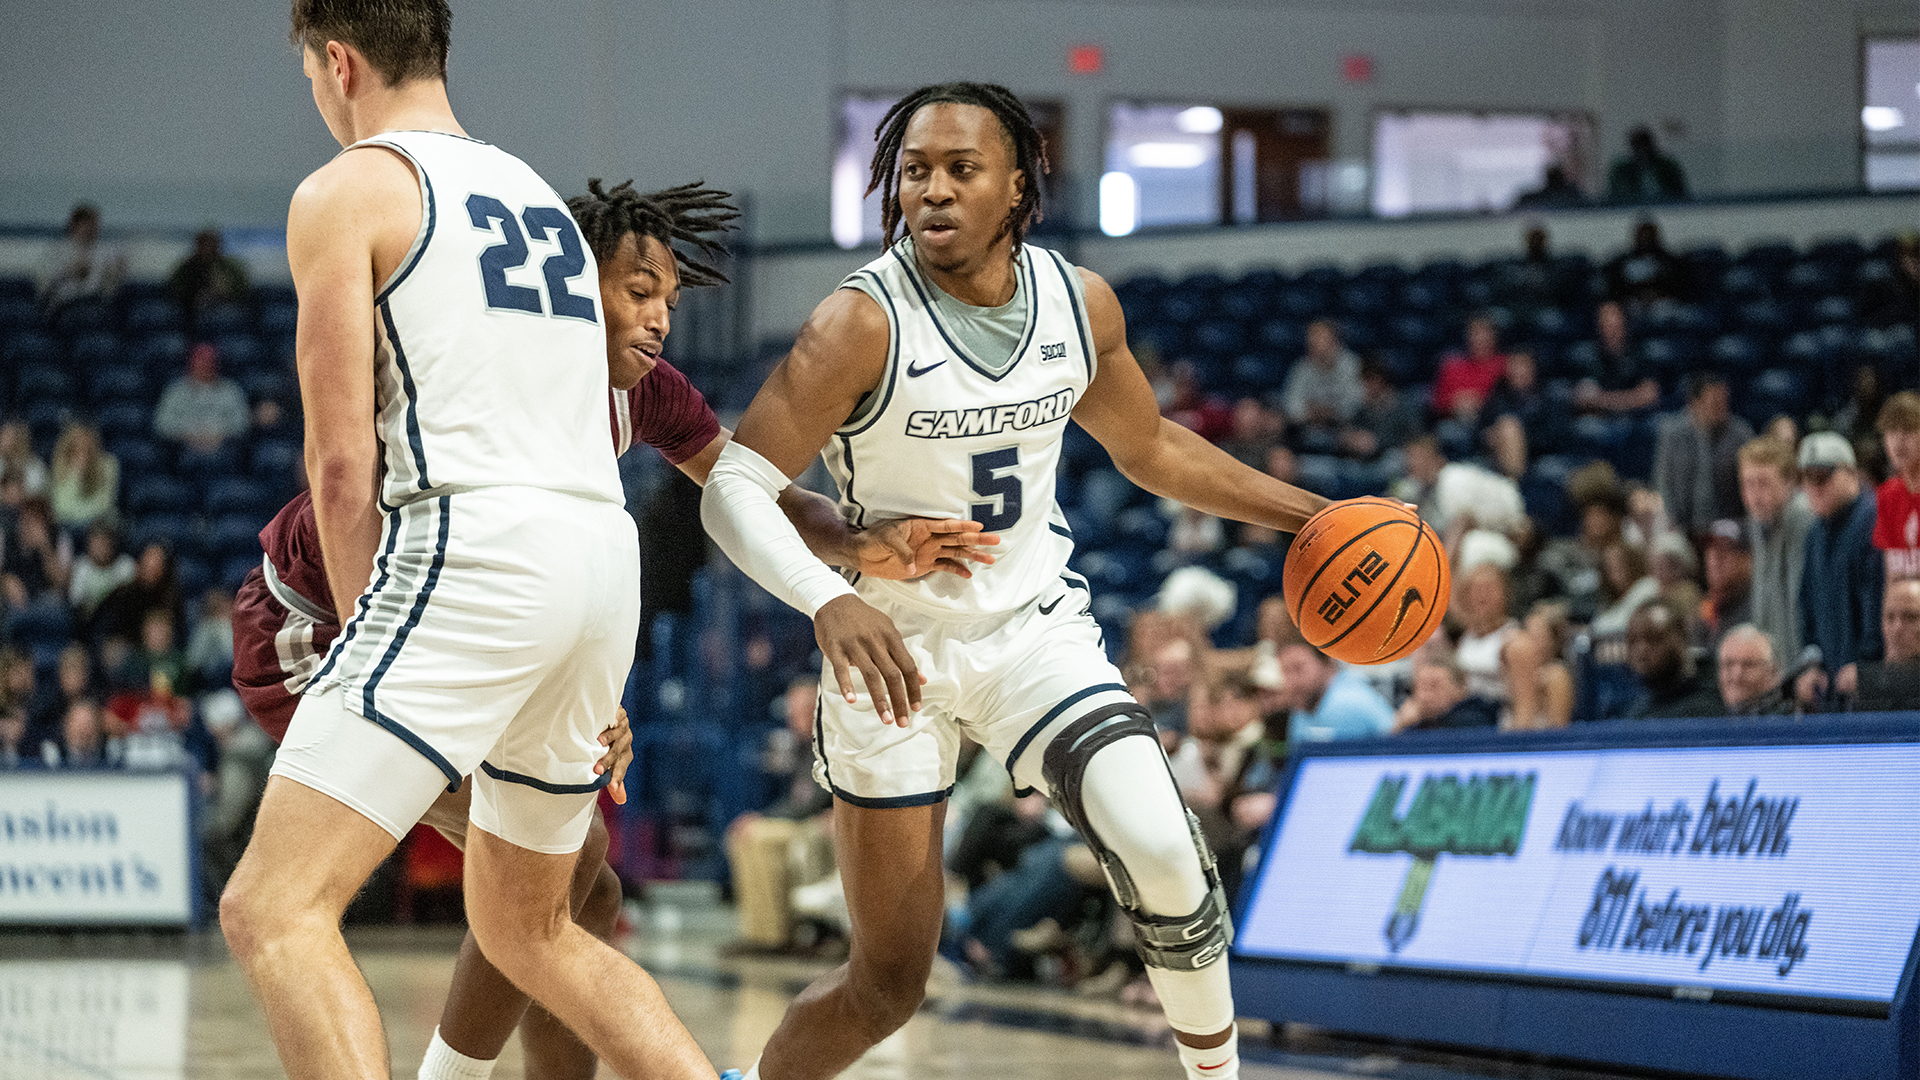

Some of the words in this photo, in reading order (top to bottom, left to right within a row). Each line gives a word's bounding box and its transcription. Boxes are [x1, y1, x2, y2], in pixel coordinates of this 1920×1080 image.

[462, 191, 600, 327] 22
[905, 387, 1075, 439] SAMFORD
[967, 442, 1023, 533] 5
[1317, 550, 1390, 625] ELITE
[1554, 799, 1616, 853] Know
[1622, 886, 1712, 955] before
[1697, 903, 1764, 972] you
